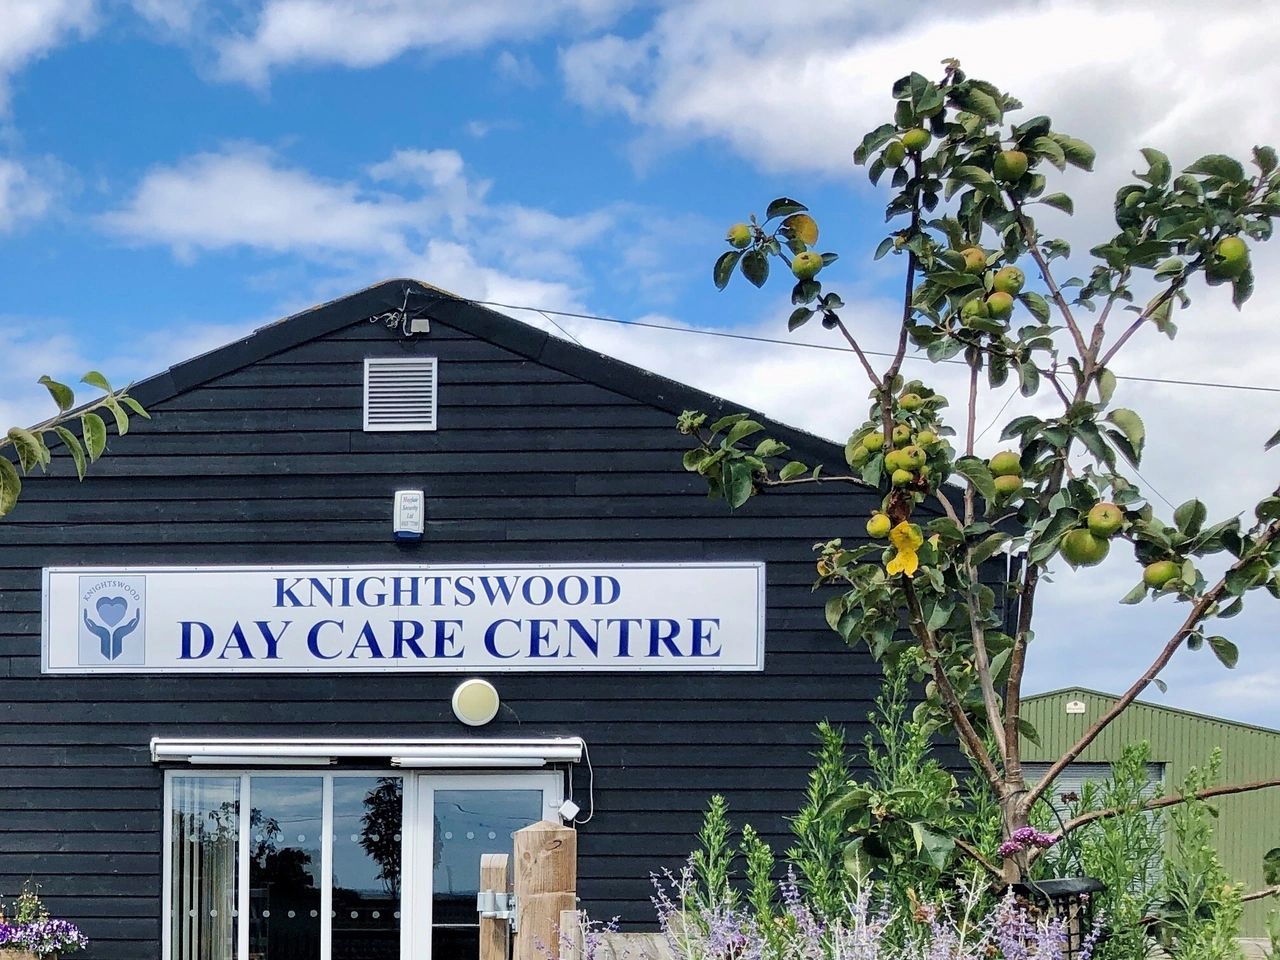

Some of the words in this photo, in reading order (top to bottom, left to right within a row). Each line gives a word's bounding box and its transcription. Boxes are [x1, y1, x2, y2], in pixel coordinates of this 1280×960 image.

[83, 580, 140, 602] KNIGHTSWOOD
[274, 575, 621, 608] KNIGHTSWOOD
[176, 620, 293, 660] DAY
[306, 619, 466, 659] CARE
[483, 618, 723, 658] CENTRE
